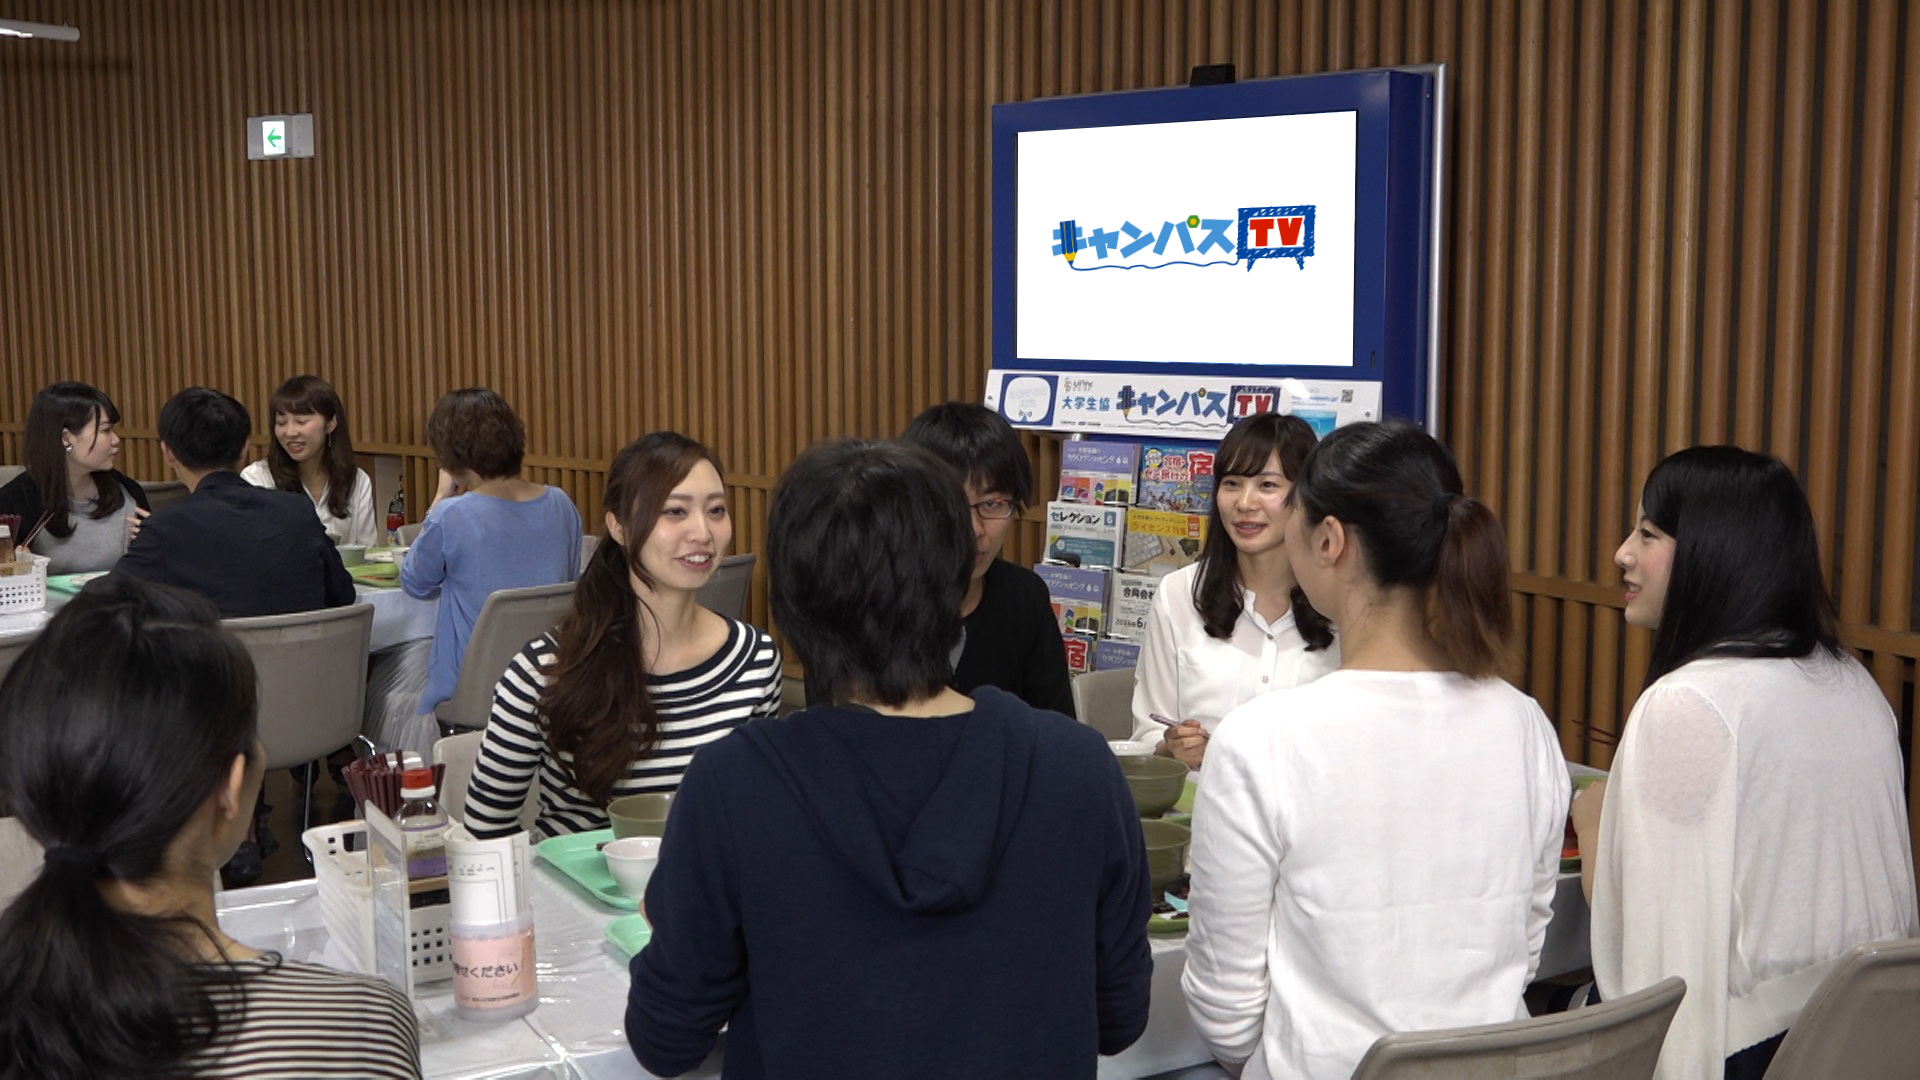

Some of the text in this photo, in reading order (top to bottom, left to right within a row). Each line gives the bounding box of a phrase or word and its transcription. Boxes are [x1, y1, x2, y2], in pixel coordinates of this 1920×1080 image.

[1061, 395, 1111, 412] 大学生協
[1188, 452, 1214, 481] 宿
[1050, 511, 1101, 526] セレクション
